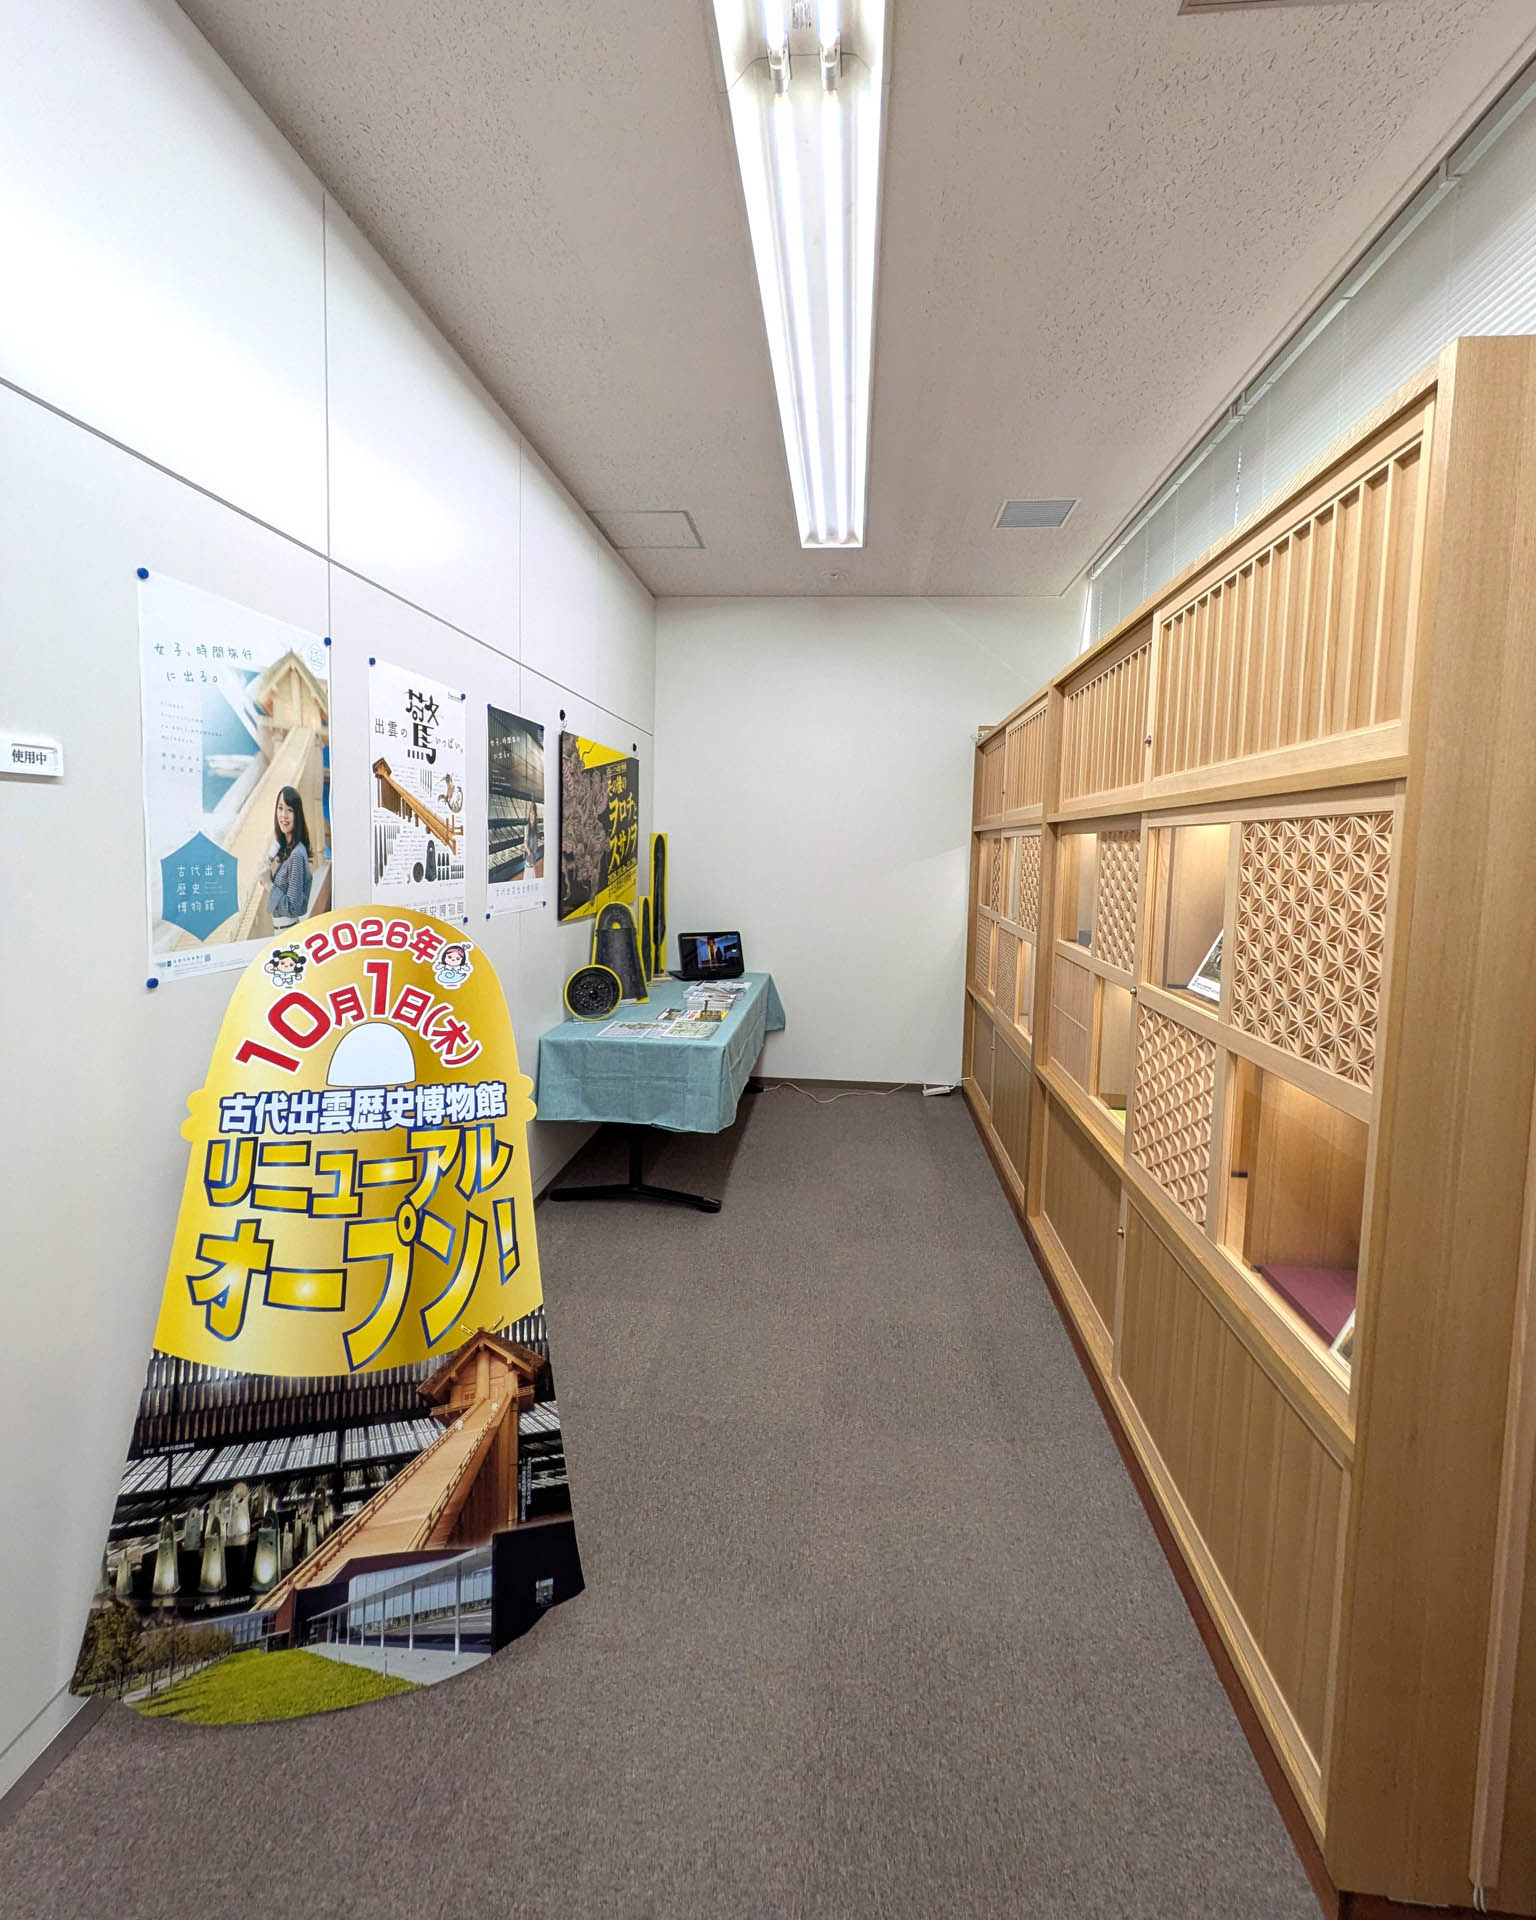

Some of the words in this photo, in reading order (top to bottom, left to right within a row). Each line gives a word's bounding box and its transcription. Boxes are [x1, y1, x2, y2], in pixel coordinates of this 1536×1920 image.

[375, 718, 408, 738] 出雲の
[405, 689, 439, 764] 驚
[12, 749, 47, 765] 使用中
[176, 863, 225, 877] 古代出雲
[176, 882, 201, 896] 歴史
[177, 899, 216, 914] 博物館
[304, 919, 445, 963] 2026年
[235, 961, 482, 1072] 10月1日(木)
[220, 1083, 508, 1134] 古代出雲歴史博物館
[204, 1123, 514, 1219] リニューアル
[186, 1198, 520, 1372] オープン!
